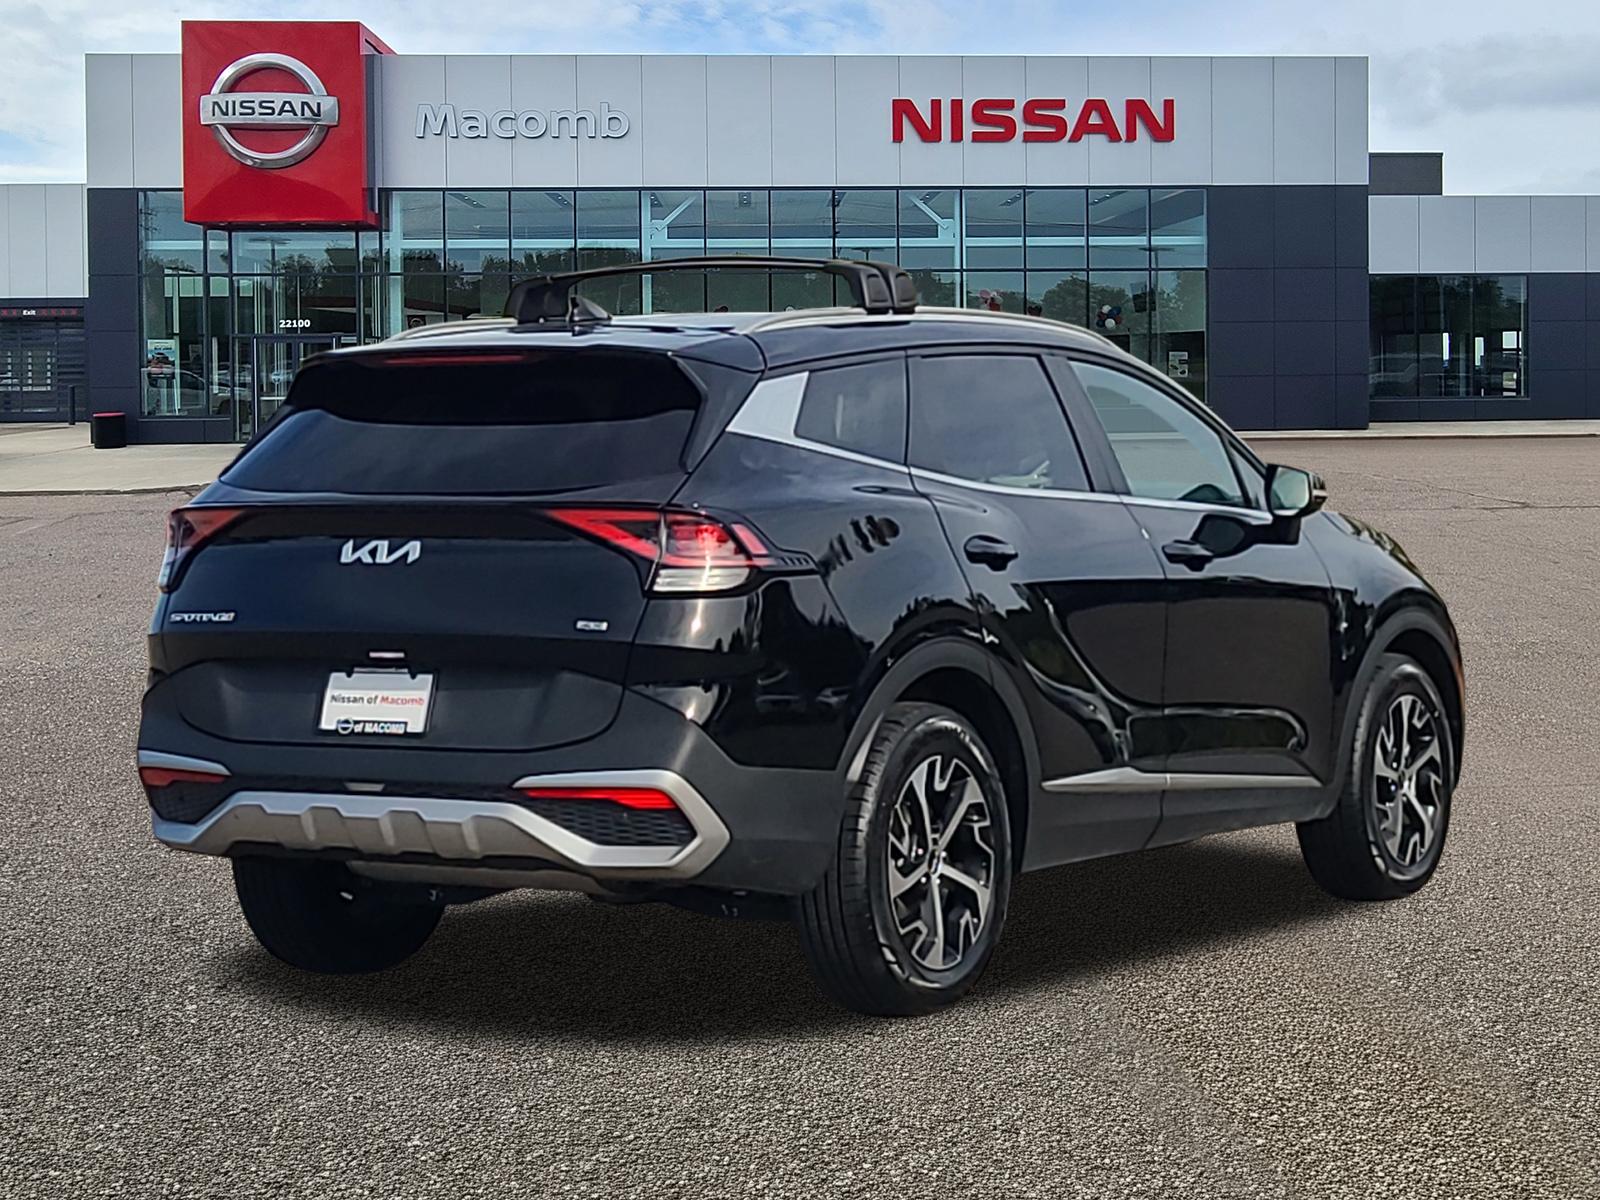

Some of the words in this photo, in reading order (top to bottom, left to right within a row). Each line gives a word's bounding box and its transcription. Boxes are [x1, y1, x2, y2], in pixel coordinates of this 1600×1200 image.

[211, 100, 322, 117] NISSAN
[415, 102, 630, 138] Macomb
[892, 98, 1175, 142] NISSAN
[279, 319, 311, 328] 22100
[330, 694, 365, 705] Nissan
[366, 695, 379, 705] of
[379, 696, 425, 706] Macomb
[363, 722, 406, 734] MACOMB
